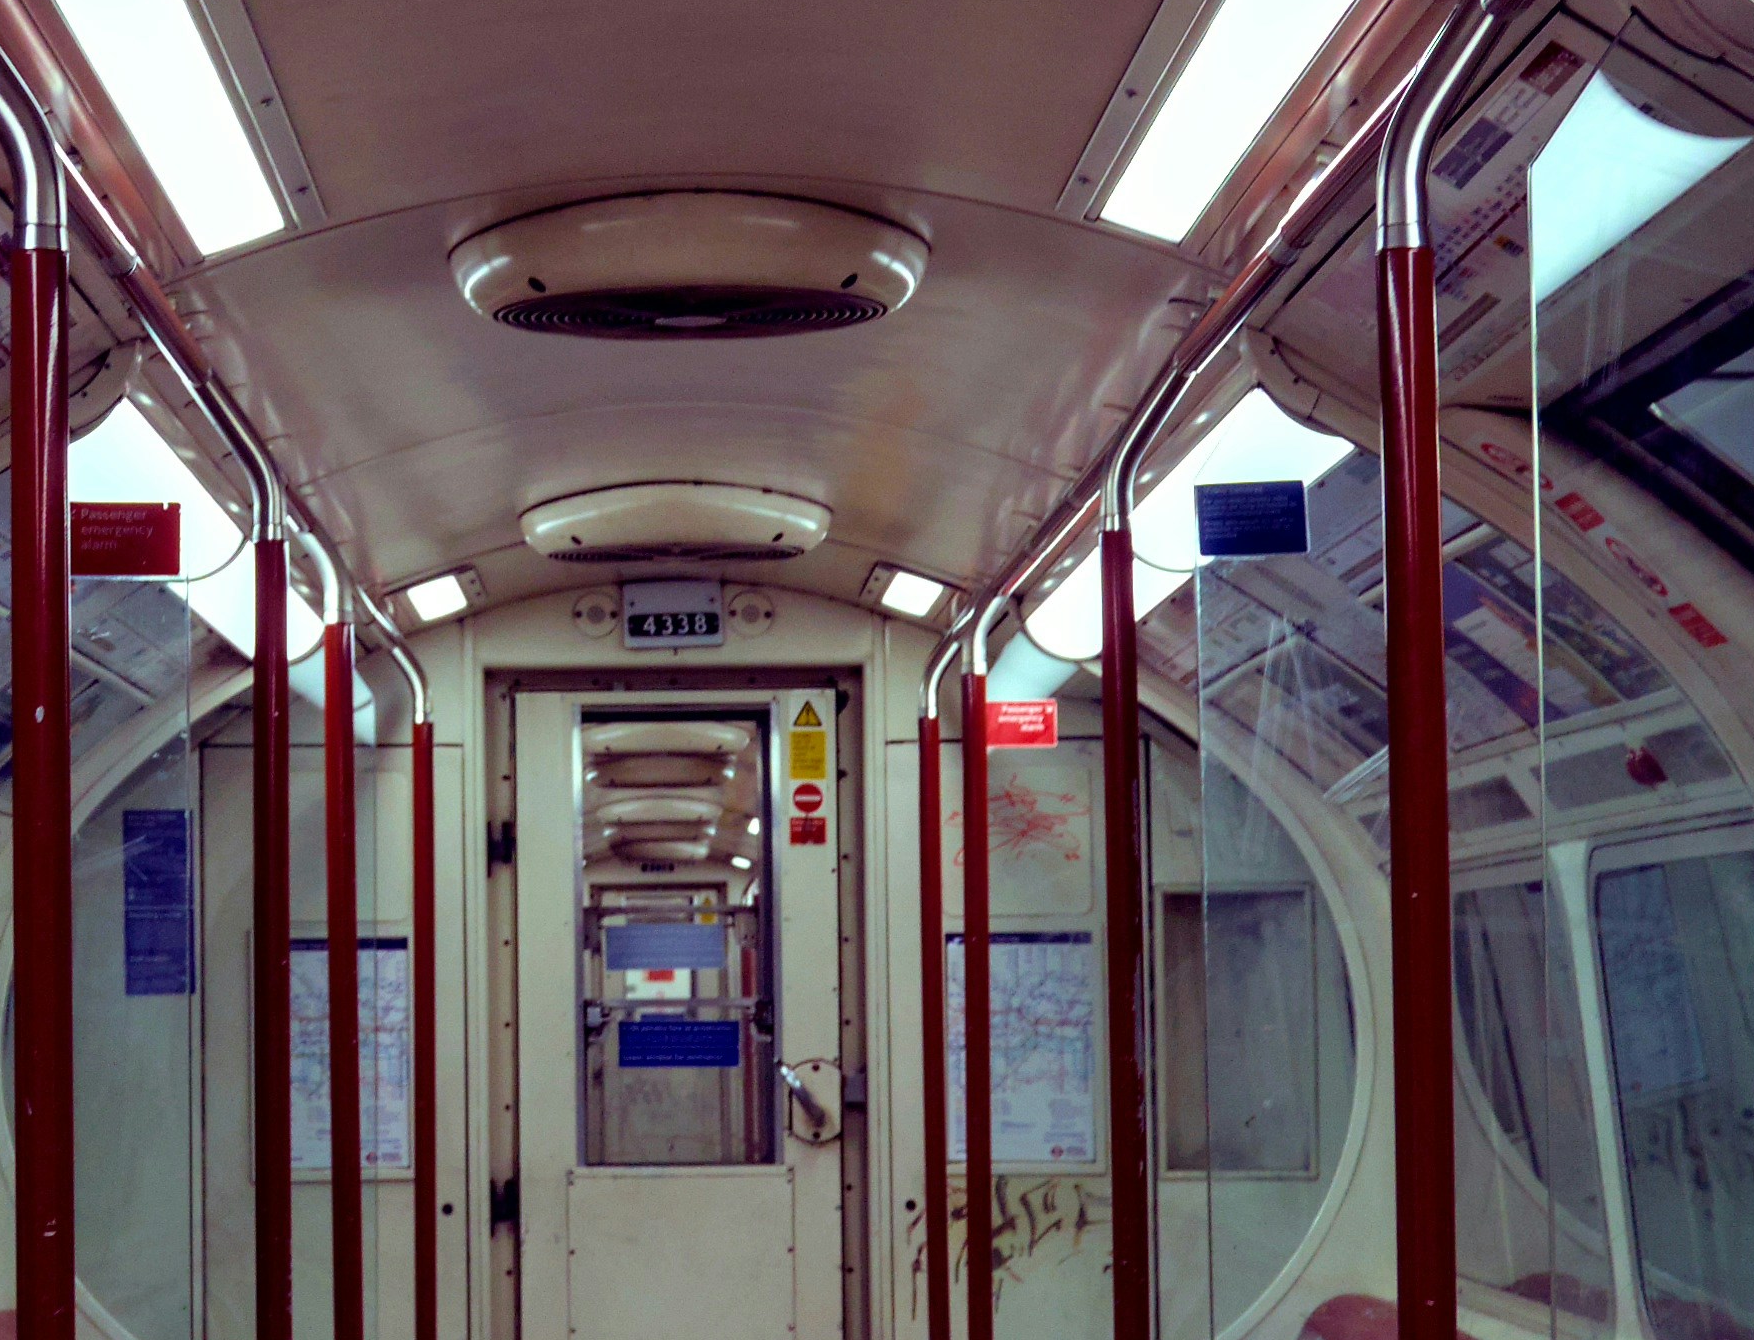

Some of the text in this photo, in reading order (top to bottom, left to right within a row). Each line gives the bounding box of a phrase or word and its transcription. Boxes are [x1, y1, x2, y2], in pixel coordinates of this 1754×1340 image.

[80, 508, 147, 523] Passenger
[80, 525, 154, 539] emergency
[80, 539, 118, 551] alarm
[642, 613, 707, 636] 4338
